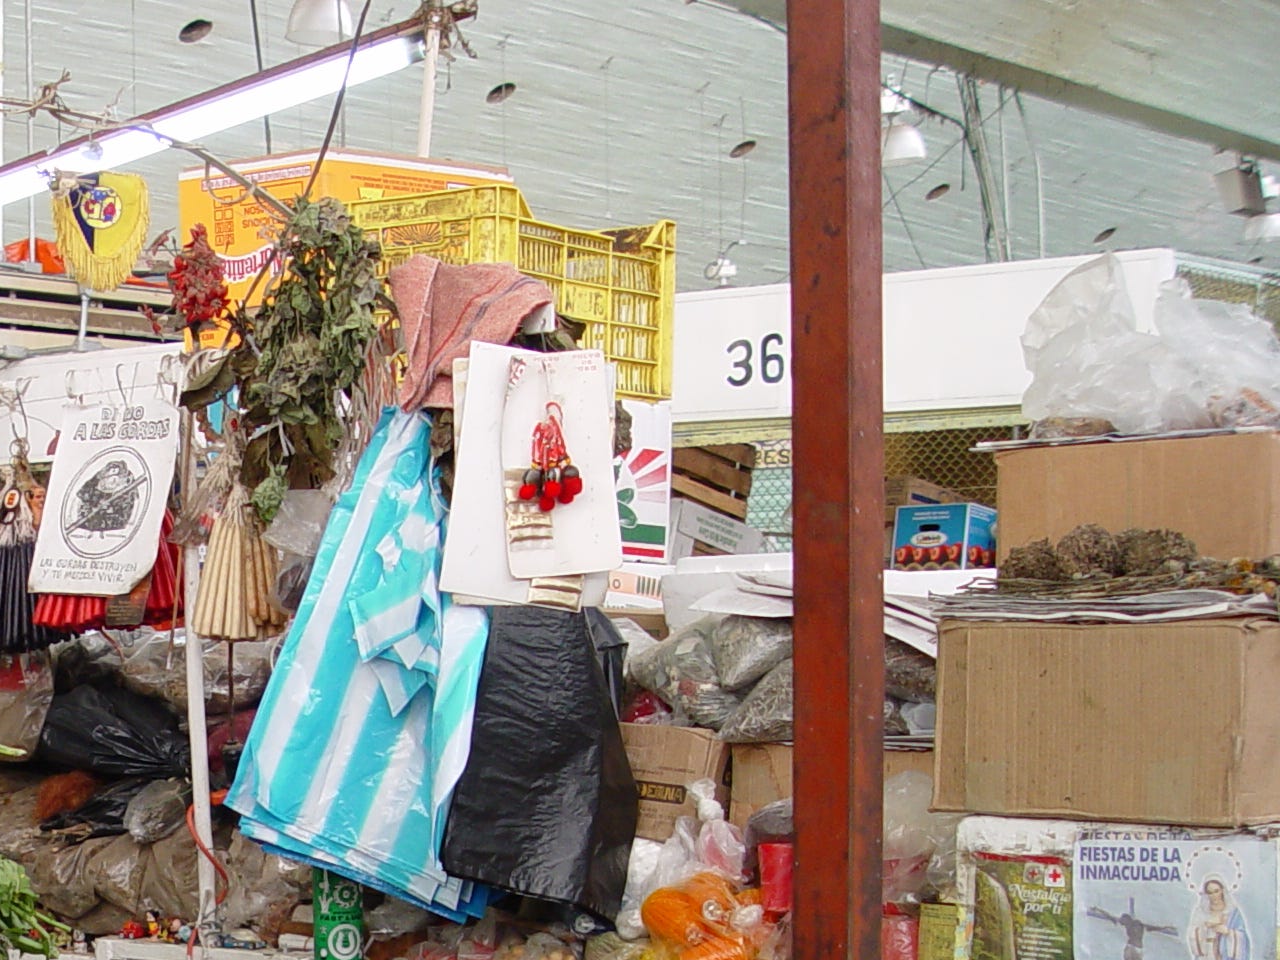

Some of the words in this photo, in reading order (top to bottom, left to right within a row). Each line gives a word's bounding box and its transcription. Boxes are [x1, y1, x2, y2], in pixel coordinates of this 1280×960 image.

[726, 332, 786, 387] 36
[73, 422, 87, 441] A
[90, 422, 117, 440] LAS
[118, 418, 170, 440] GORDAS
[1080, 846, 1135, 862] FIESTAS
[1139, 847, 1159, 862] DE
[1163, 847, 1182, 862] LA
[1080, 865, 1182, 882] INMACULADA
[1024, 902, 1051, 915] por
[1052, 902, 1064, 915] ti
